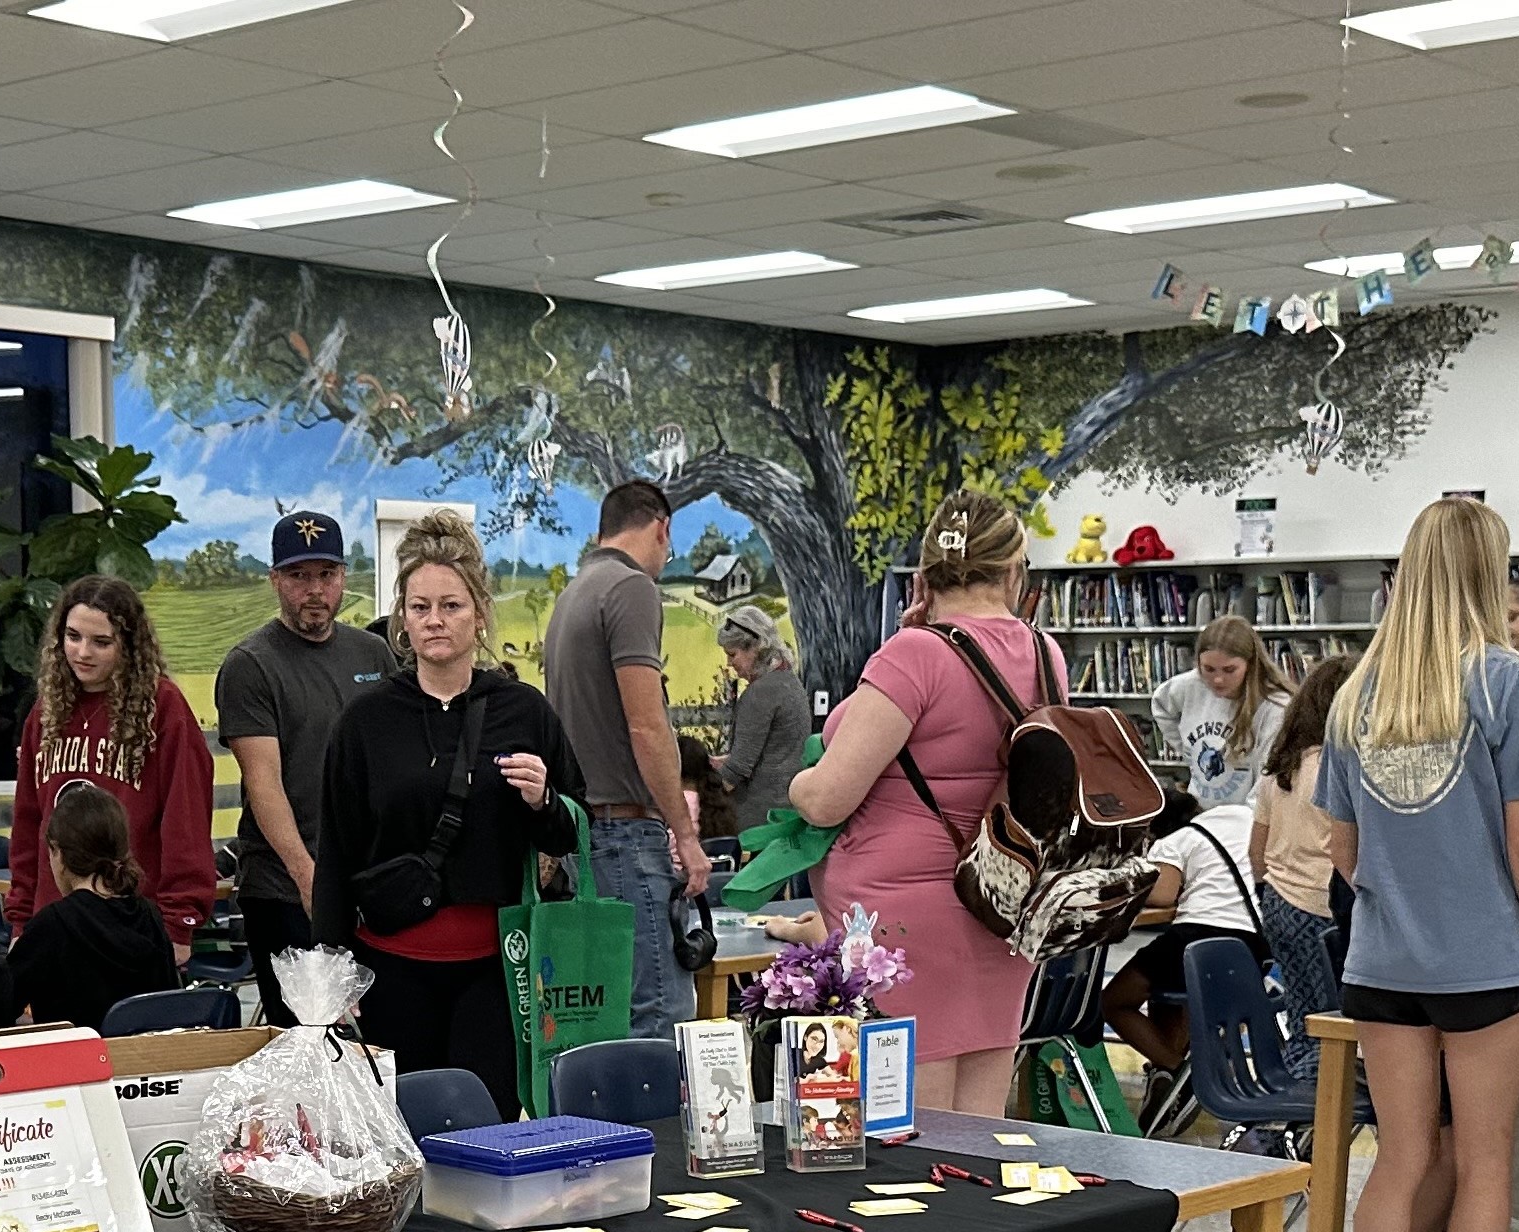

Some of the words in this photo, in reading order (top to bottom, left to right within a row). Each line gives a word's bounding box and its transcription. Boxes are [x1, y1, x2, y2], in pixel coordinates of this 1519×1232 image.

[1187, 721, 1233, 746] NEWSO
[35, 736, 89, 789] FLRIDA
[514, 967, 531, 1016] GREEN
[543, 985, 604, 1011] STEM
[876, 1035, 899, 1048] Table
[884, 1057, 890, 1068] 1
